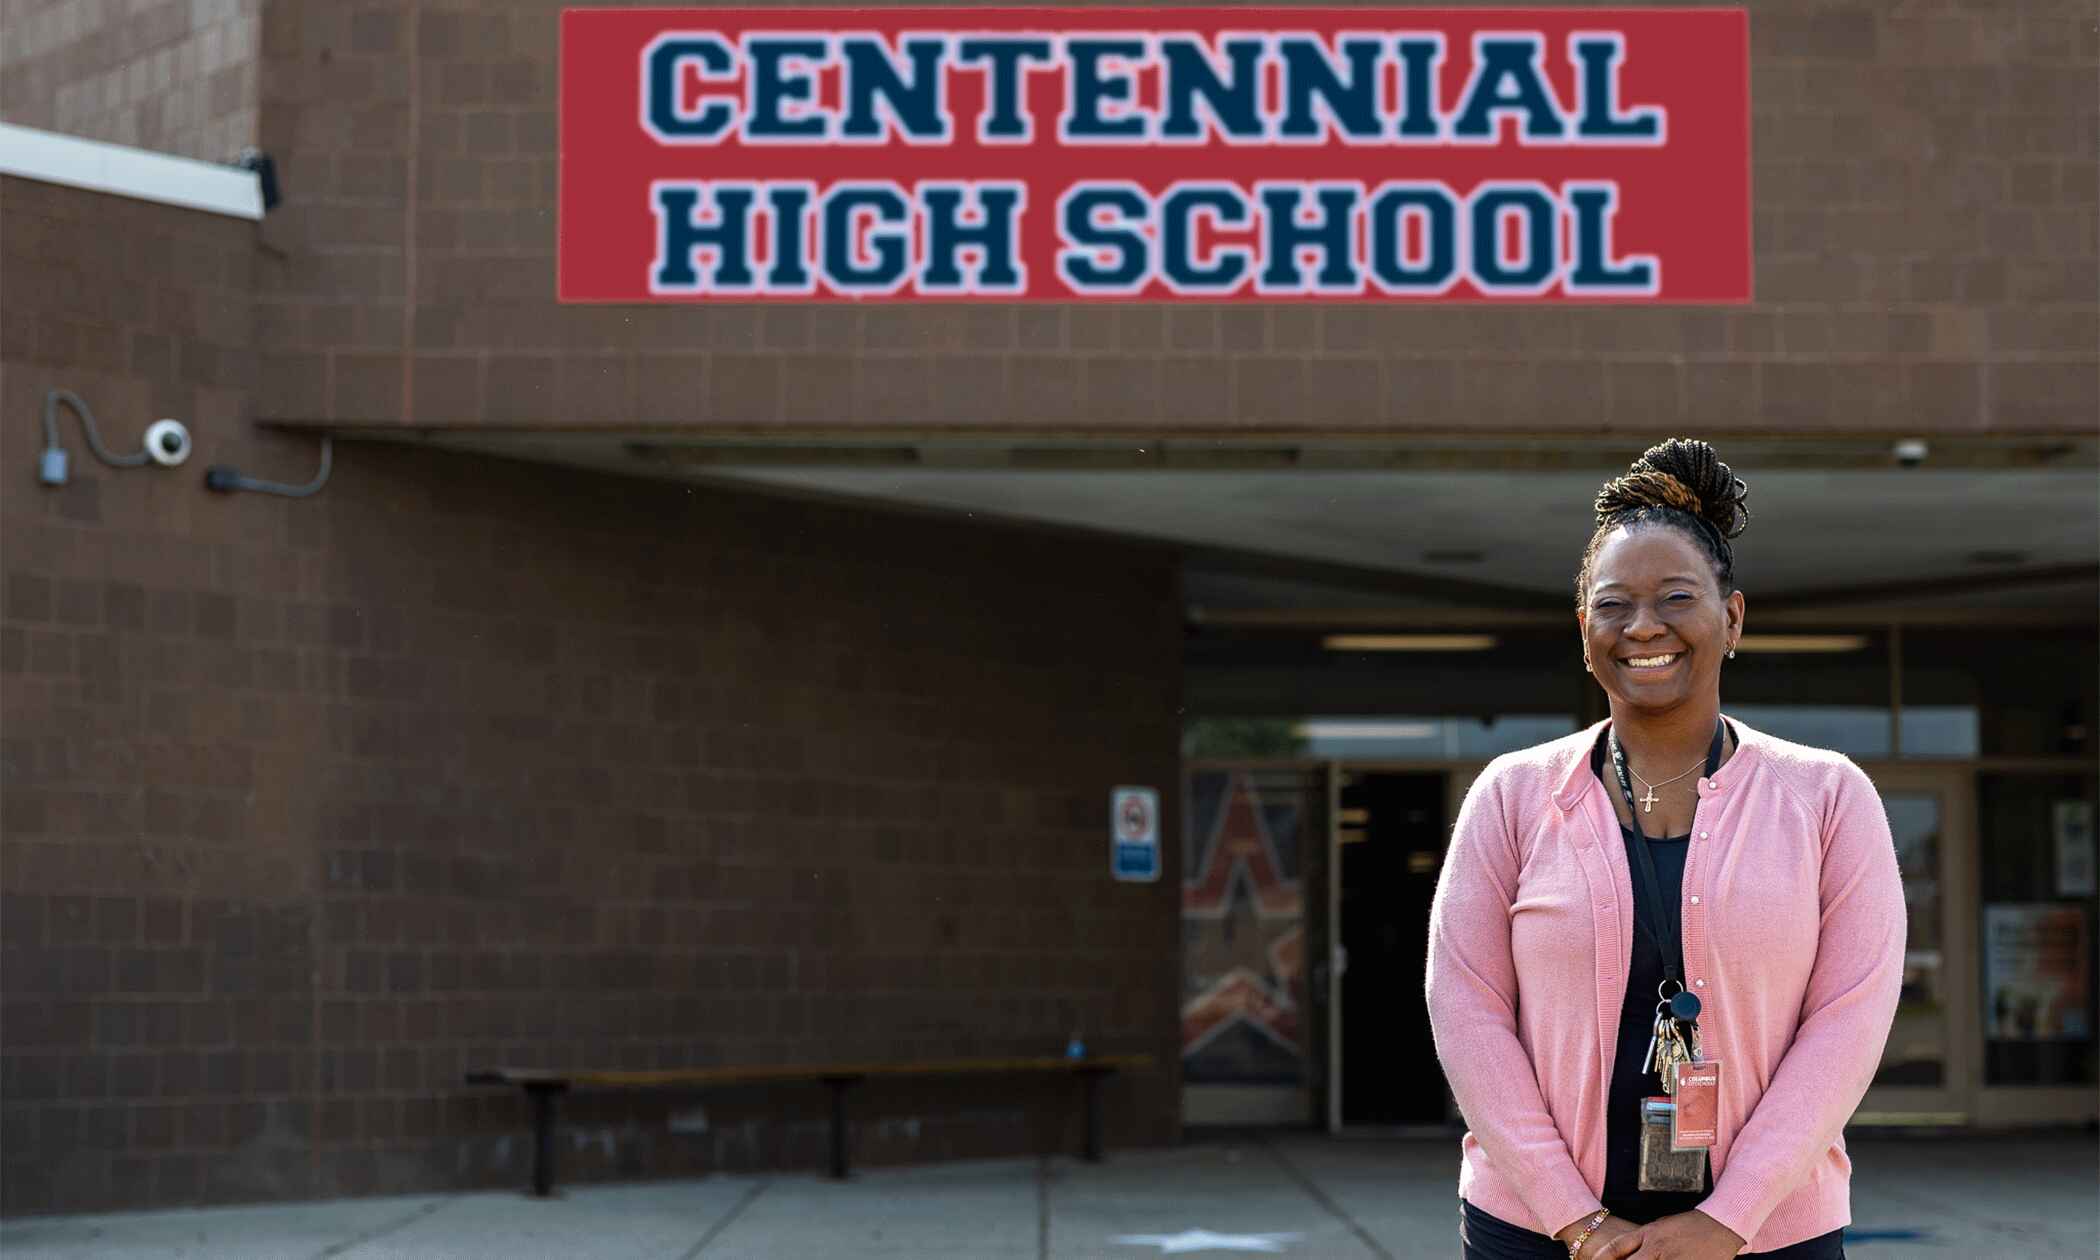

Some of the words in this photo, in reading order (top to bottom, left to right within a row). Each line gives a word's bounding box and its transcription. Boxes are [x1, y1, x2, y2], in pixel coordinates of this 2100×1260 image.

[642, 32, 1665, 143] CENTENNIAL
[650, 182, 1025, 292] HIGH
[1057, 182, 1658, 292] SCHOOL
